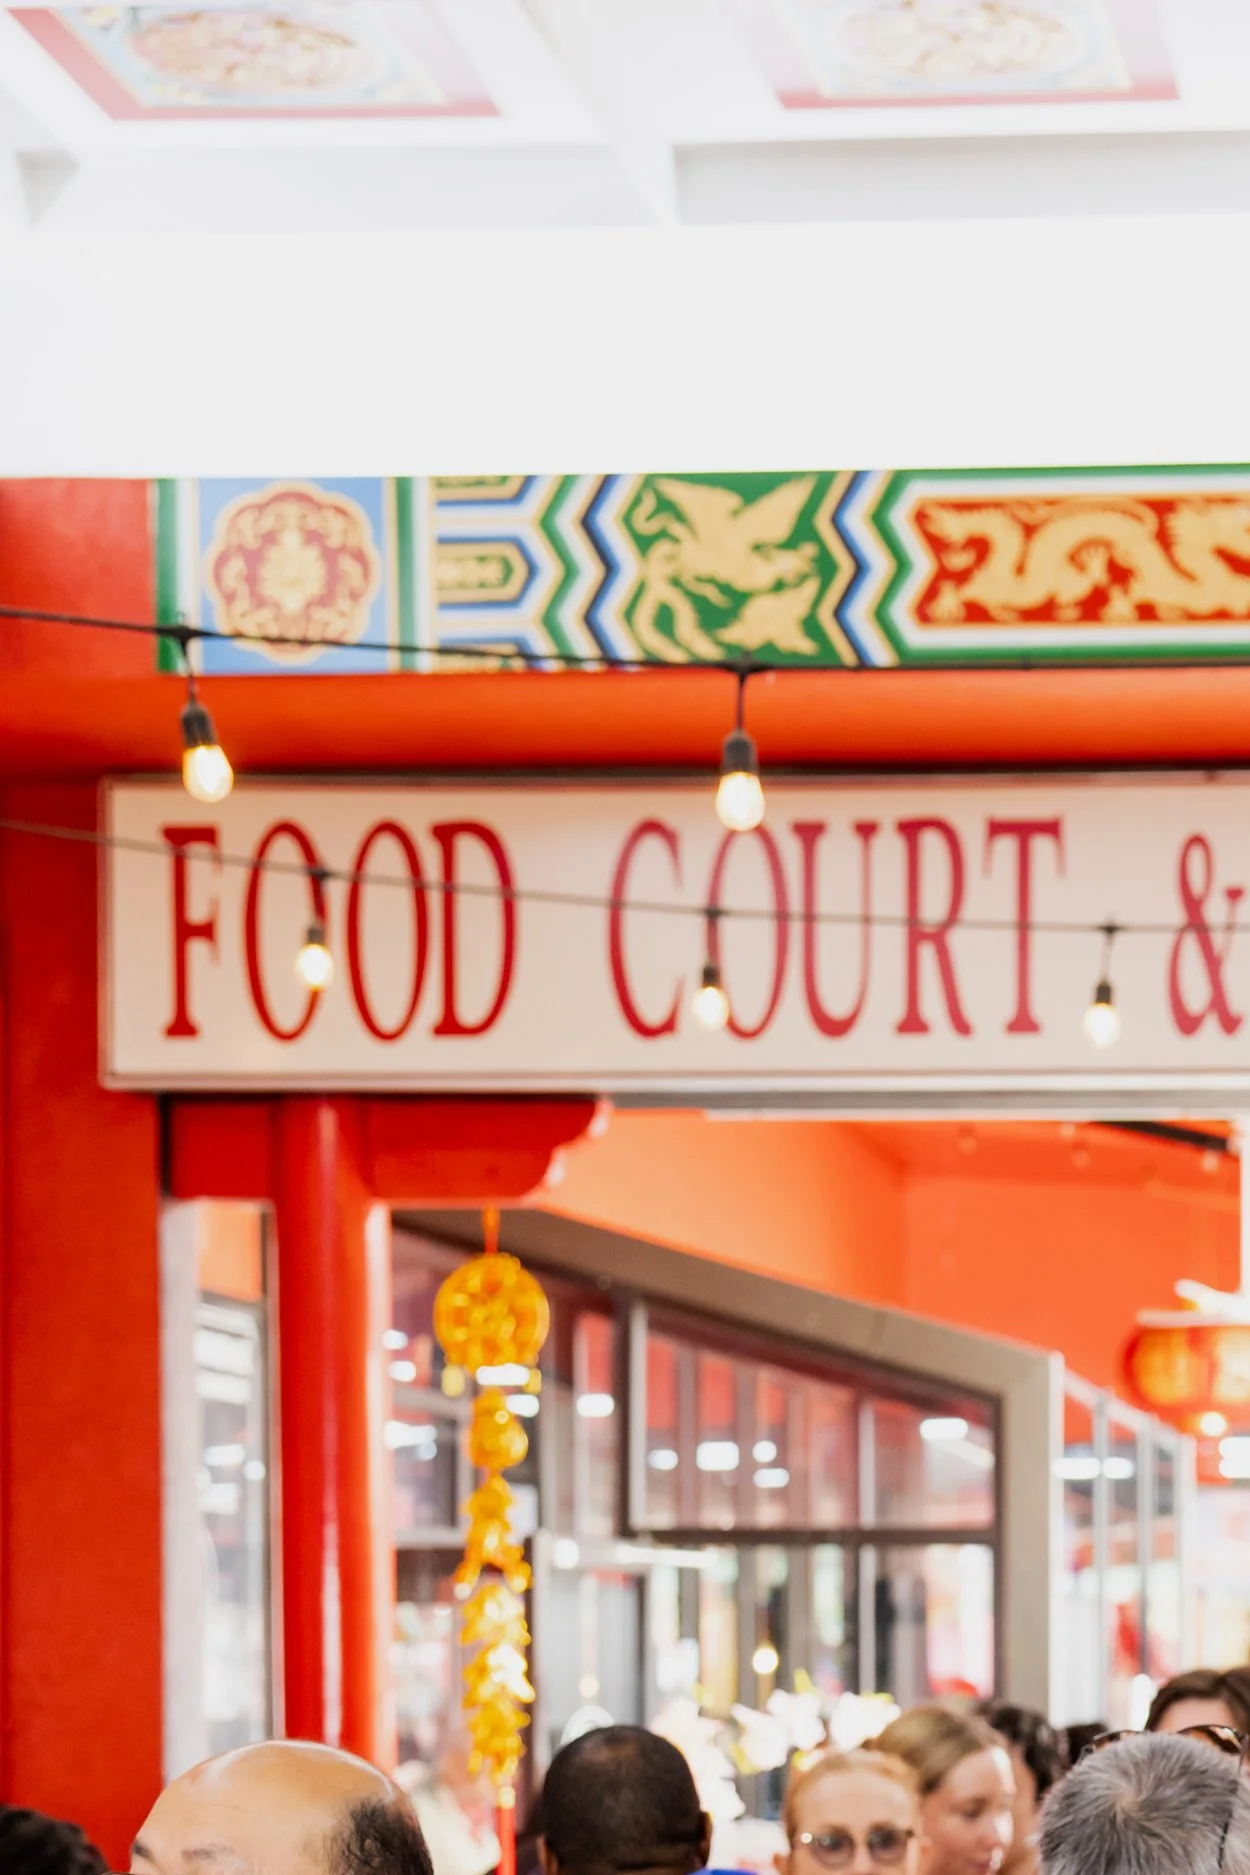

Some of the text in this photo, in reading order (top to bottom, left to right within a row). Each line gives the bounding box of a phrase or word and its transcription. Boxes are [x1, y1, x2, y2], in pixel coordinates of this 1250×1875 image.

[161, 819, 517, 1044] FOOD
[608, 816, 1066, 1041] COURT
[1168, 832, 1246, 1037] &
